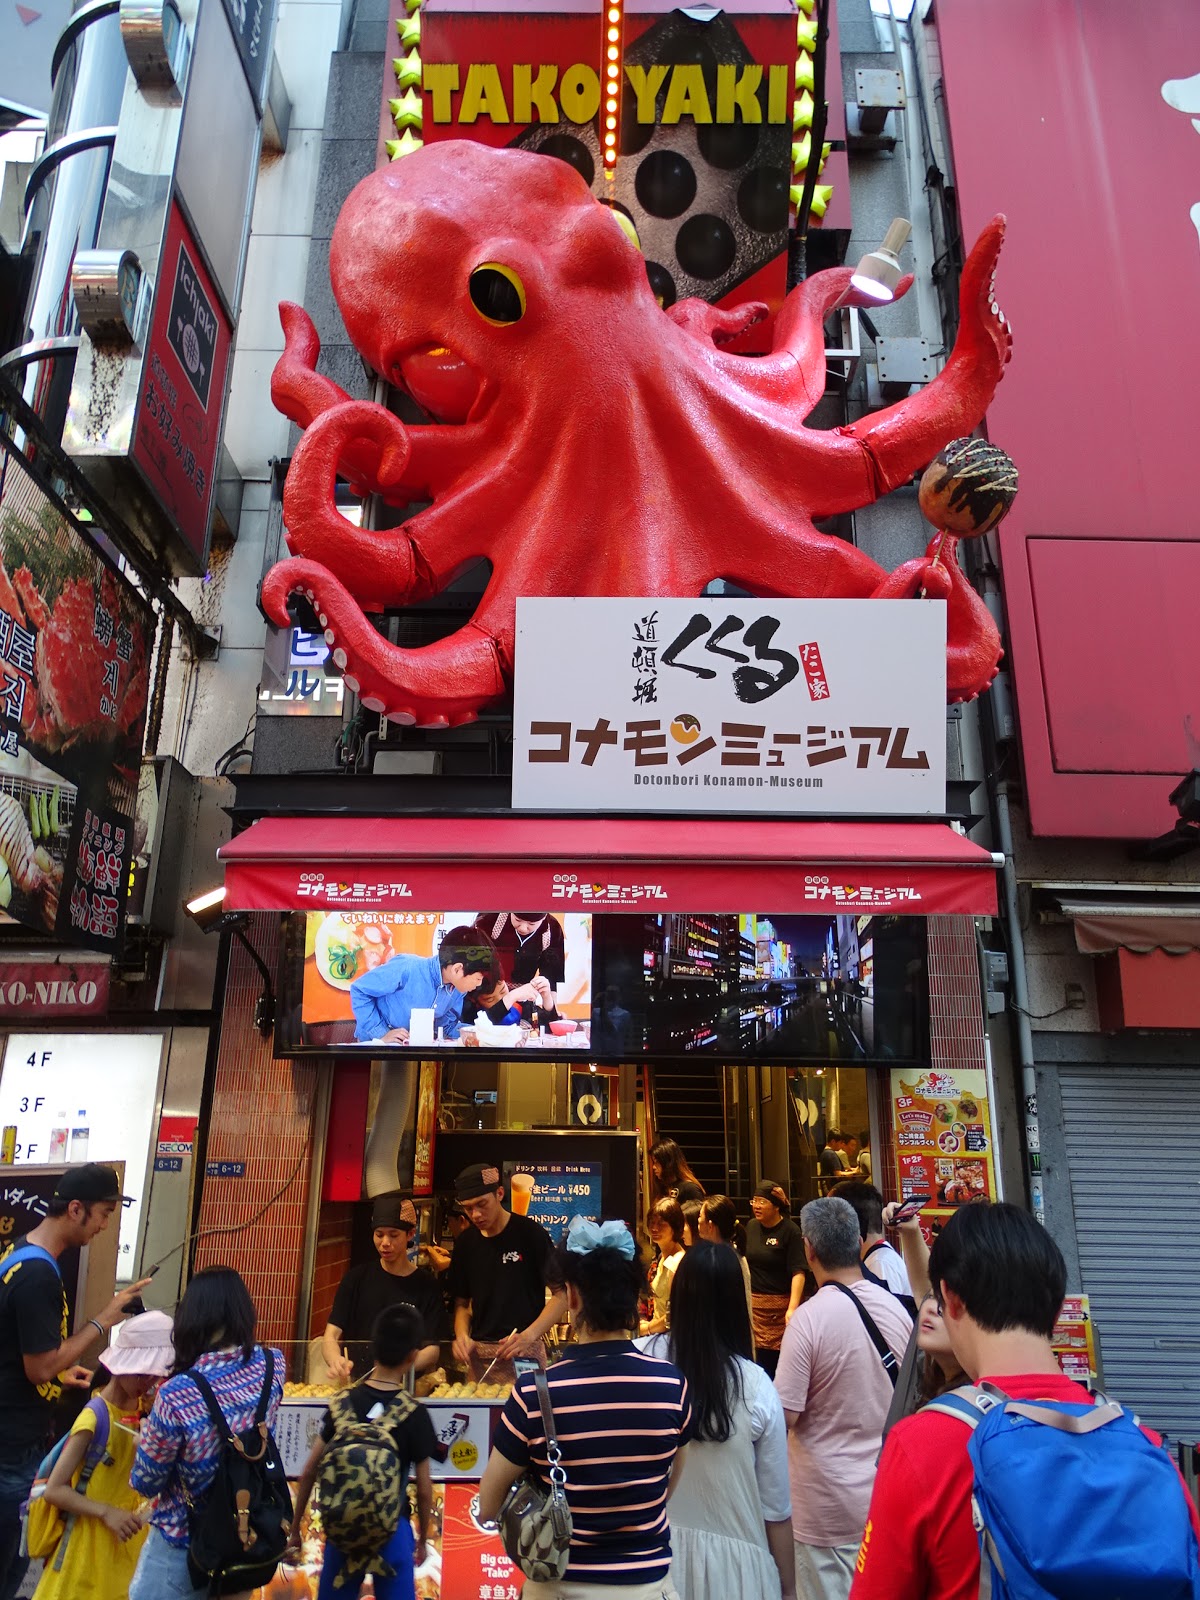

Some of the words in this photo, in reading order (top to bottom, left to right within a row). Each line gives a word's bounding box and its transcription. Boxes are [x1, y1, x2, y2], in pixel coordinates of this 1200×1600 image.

[423, 63, 600, 124] TAKO
[624, 64, 789, 124] YAKI
[145, 379, 206, 500] お好み焼き
[632, 610, 660, 706] 道頓堀
[660, 613, 800, 704] くくる
[802, 644, 828, 699] たこ家
[528, 714, 931, 769] コナモンミュージアム
[633, 773, 699, 787] Dotonbori
[703, 773, 823, 788] Konamon-Museum
[297, 882, 412, 897] コナモンミュージアム
[552, 883, 668, 898] コナモンミュージアム
[804, 885, 922, 900] コナモンミュージアム
[341, 913, 445, 925] ていねいに教えます！
[898, 1098, 913, 1108] 3F
[159, 1143, 193, 1153] SECOM
[158, 1160, 180, 1169] 6-12
[221, 1164, 242, 1174] 6-12
[568, 1184, 590, 1196] ¥450
[480, 1554, 496, 1565] Big
